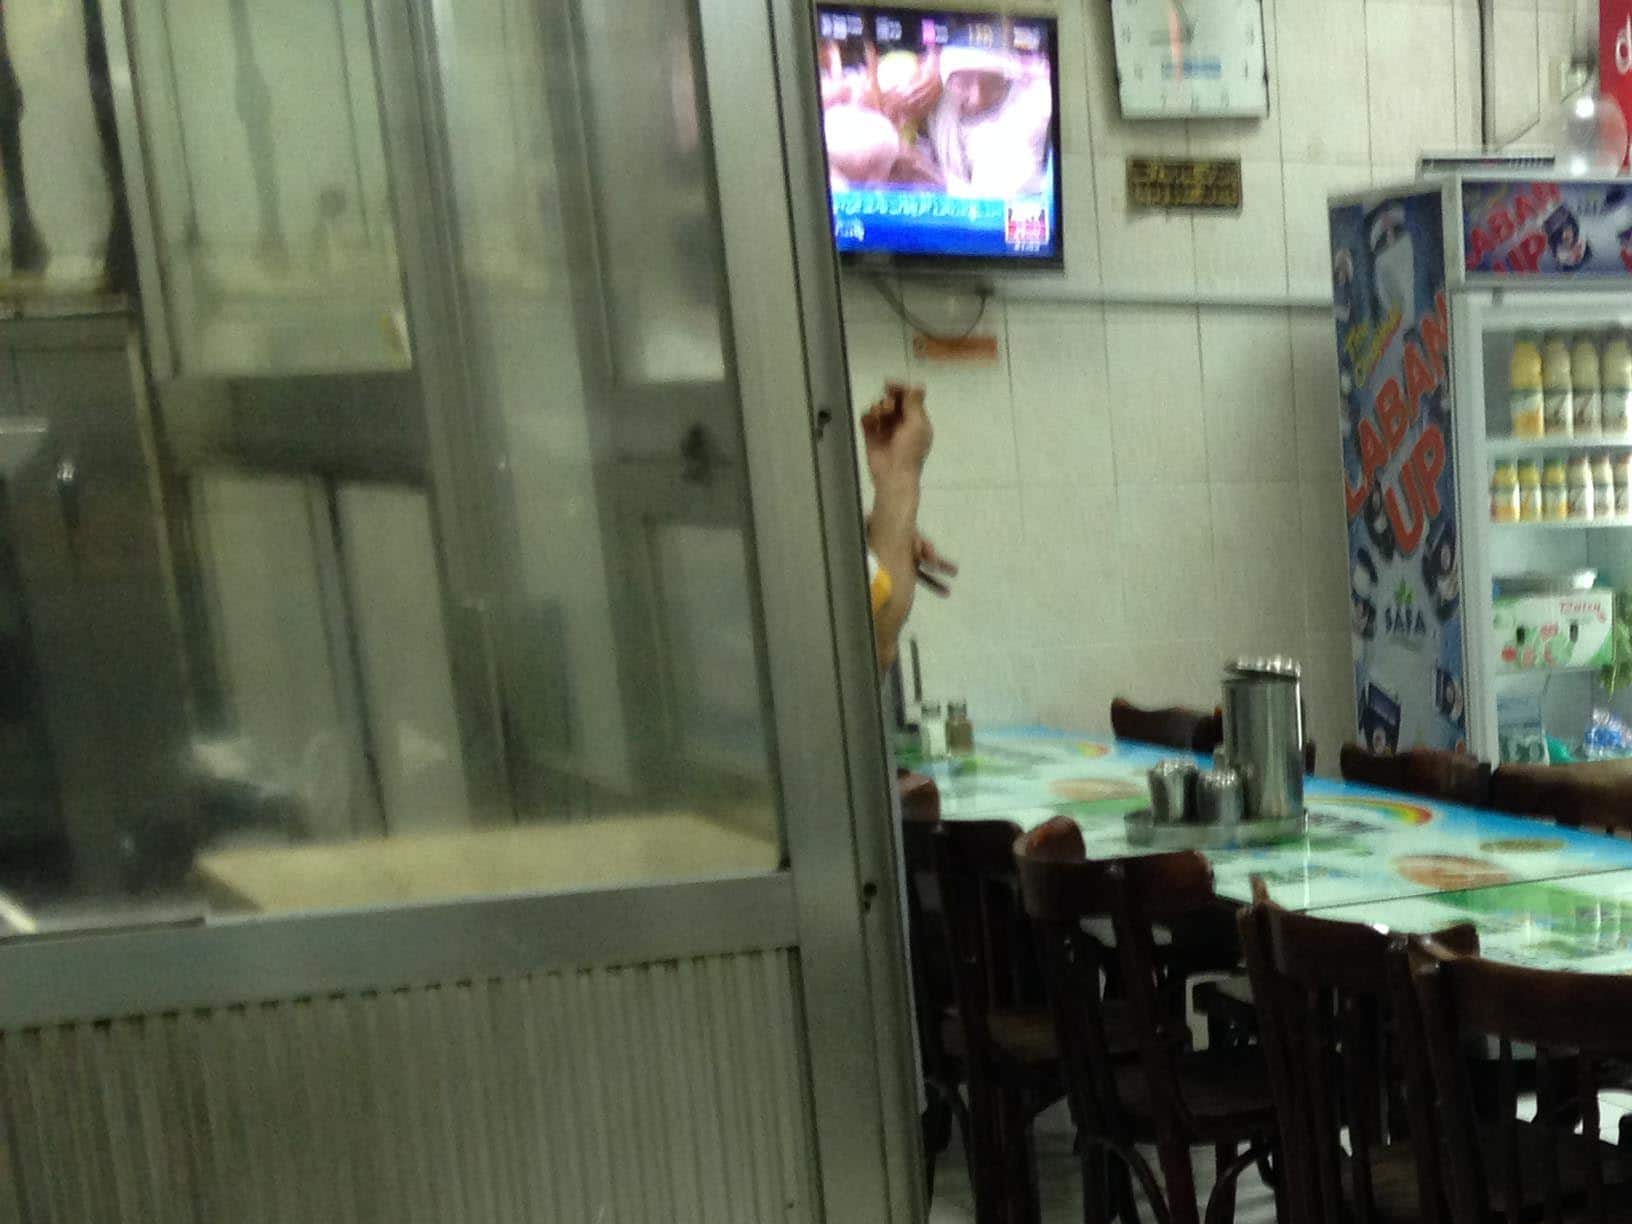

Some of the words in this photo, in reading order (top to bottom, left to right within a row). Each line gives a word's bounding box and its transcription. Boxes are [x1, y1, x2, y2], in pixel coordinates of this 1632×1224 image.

[1344, 290, 1450, 520] LABAN
[1385, 424, 1446, 552] UP
[1385, 606, 1427, 637] SAFA
